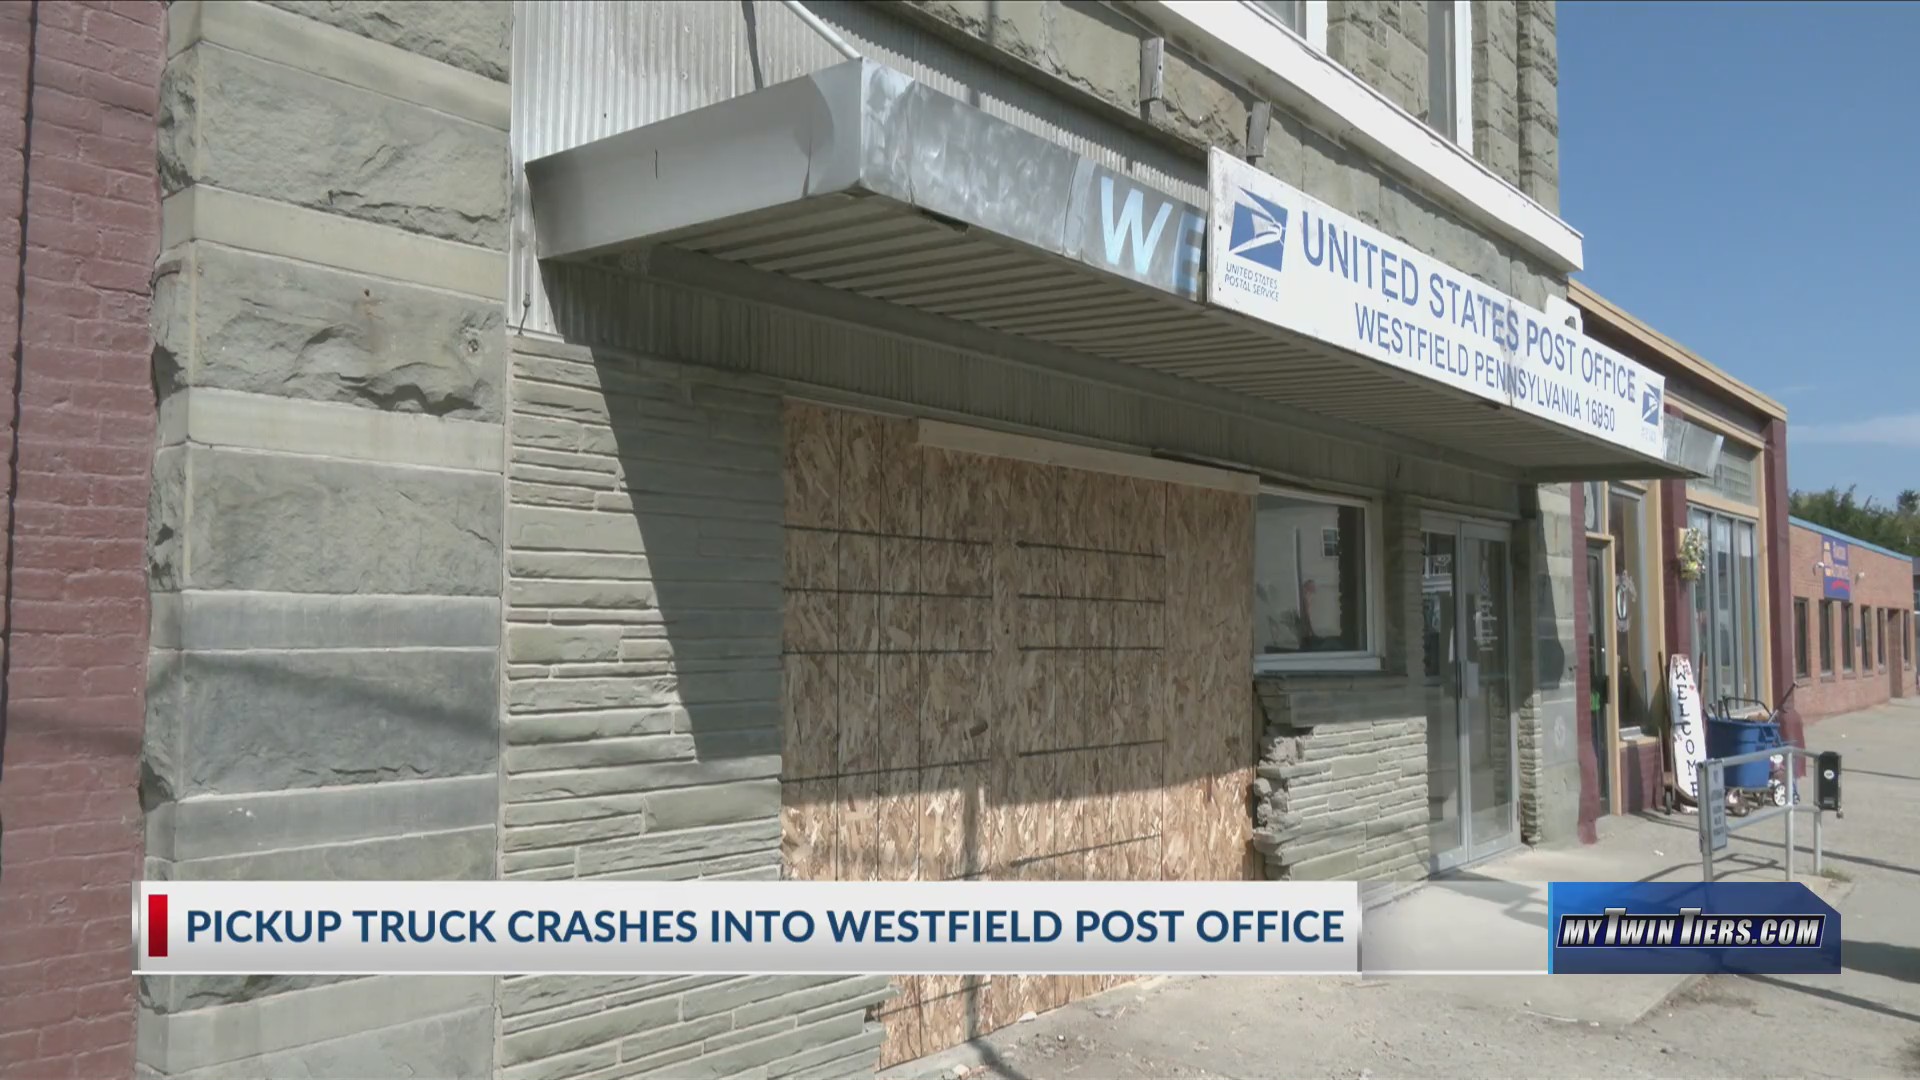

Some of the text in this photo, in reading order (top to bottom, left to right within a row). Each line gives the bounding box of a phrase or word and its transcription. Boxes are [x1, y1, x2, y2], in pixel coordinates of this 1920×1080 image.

[1224, 273, 1280, 302] POSTAL SERVICE
[1226, 261, 1278, 290] UNITED STATES
[1303, 211, 1636, 404] UNITED STATES POST OFFICE
[1355, 302, 1615, 433] WESTFIELD PENNSYLVANIA 16950
[1674, 665, 1698, 798] WELCOME
